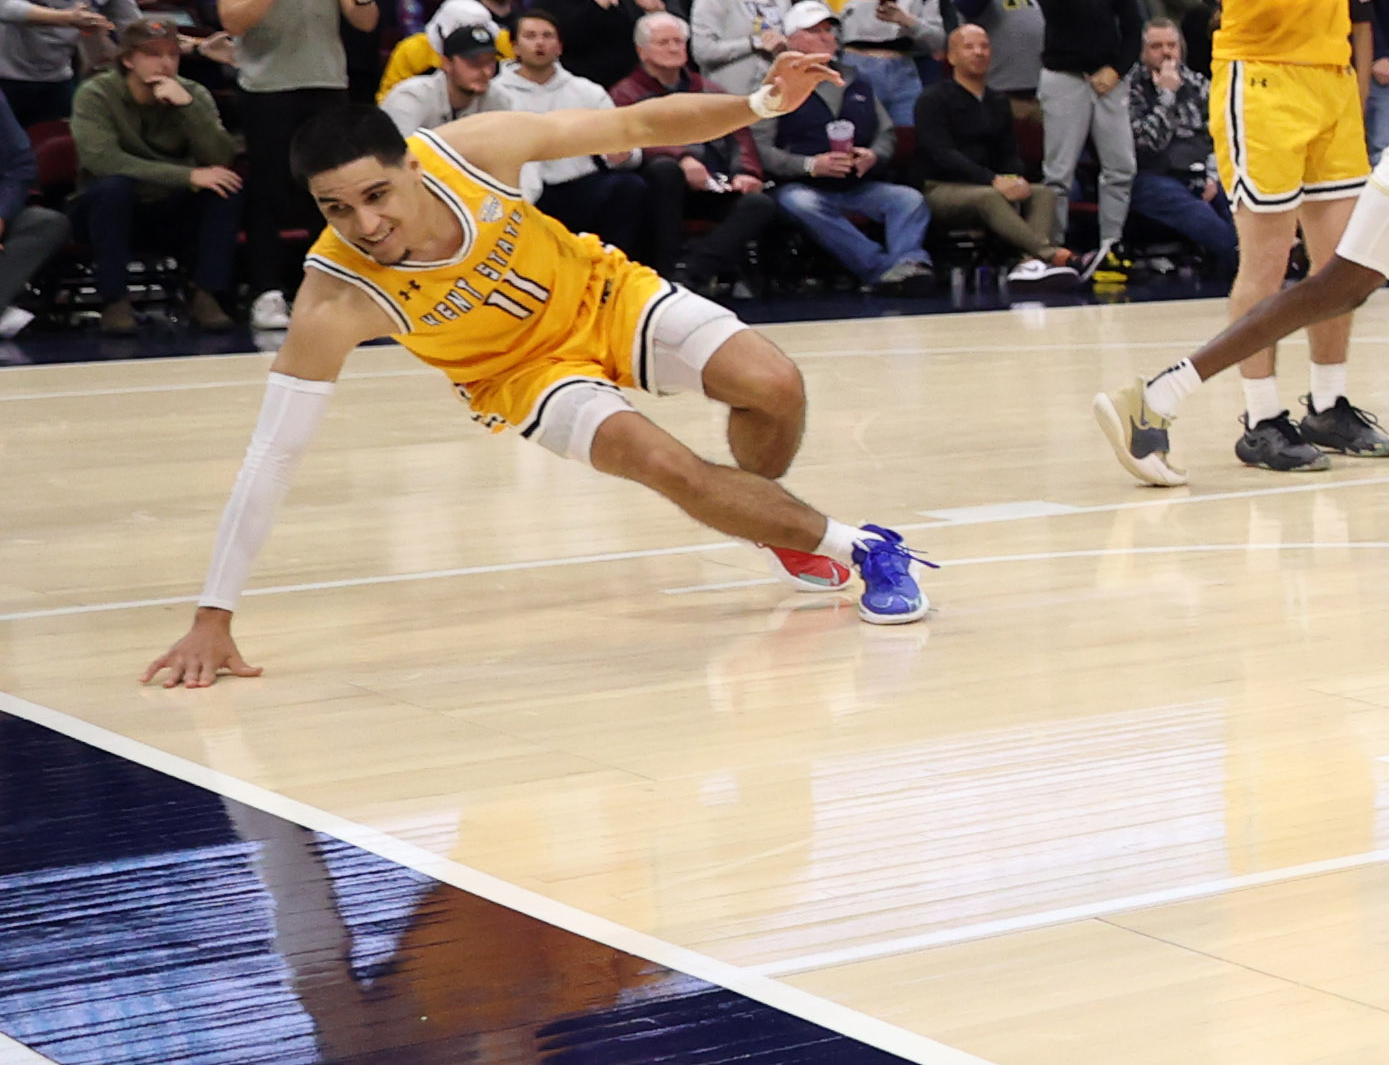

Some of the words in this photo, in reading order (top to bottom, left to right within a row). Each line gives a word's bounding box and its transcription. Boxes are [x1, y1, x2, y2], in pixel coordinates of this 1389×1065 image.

[420, 277, 485, 326] KENT
[473, 209, 523, 281] STATE
[483, 268, 551, 321] 11
